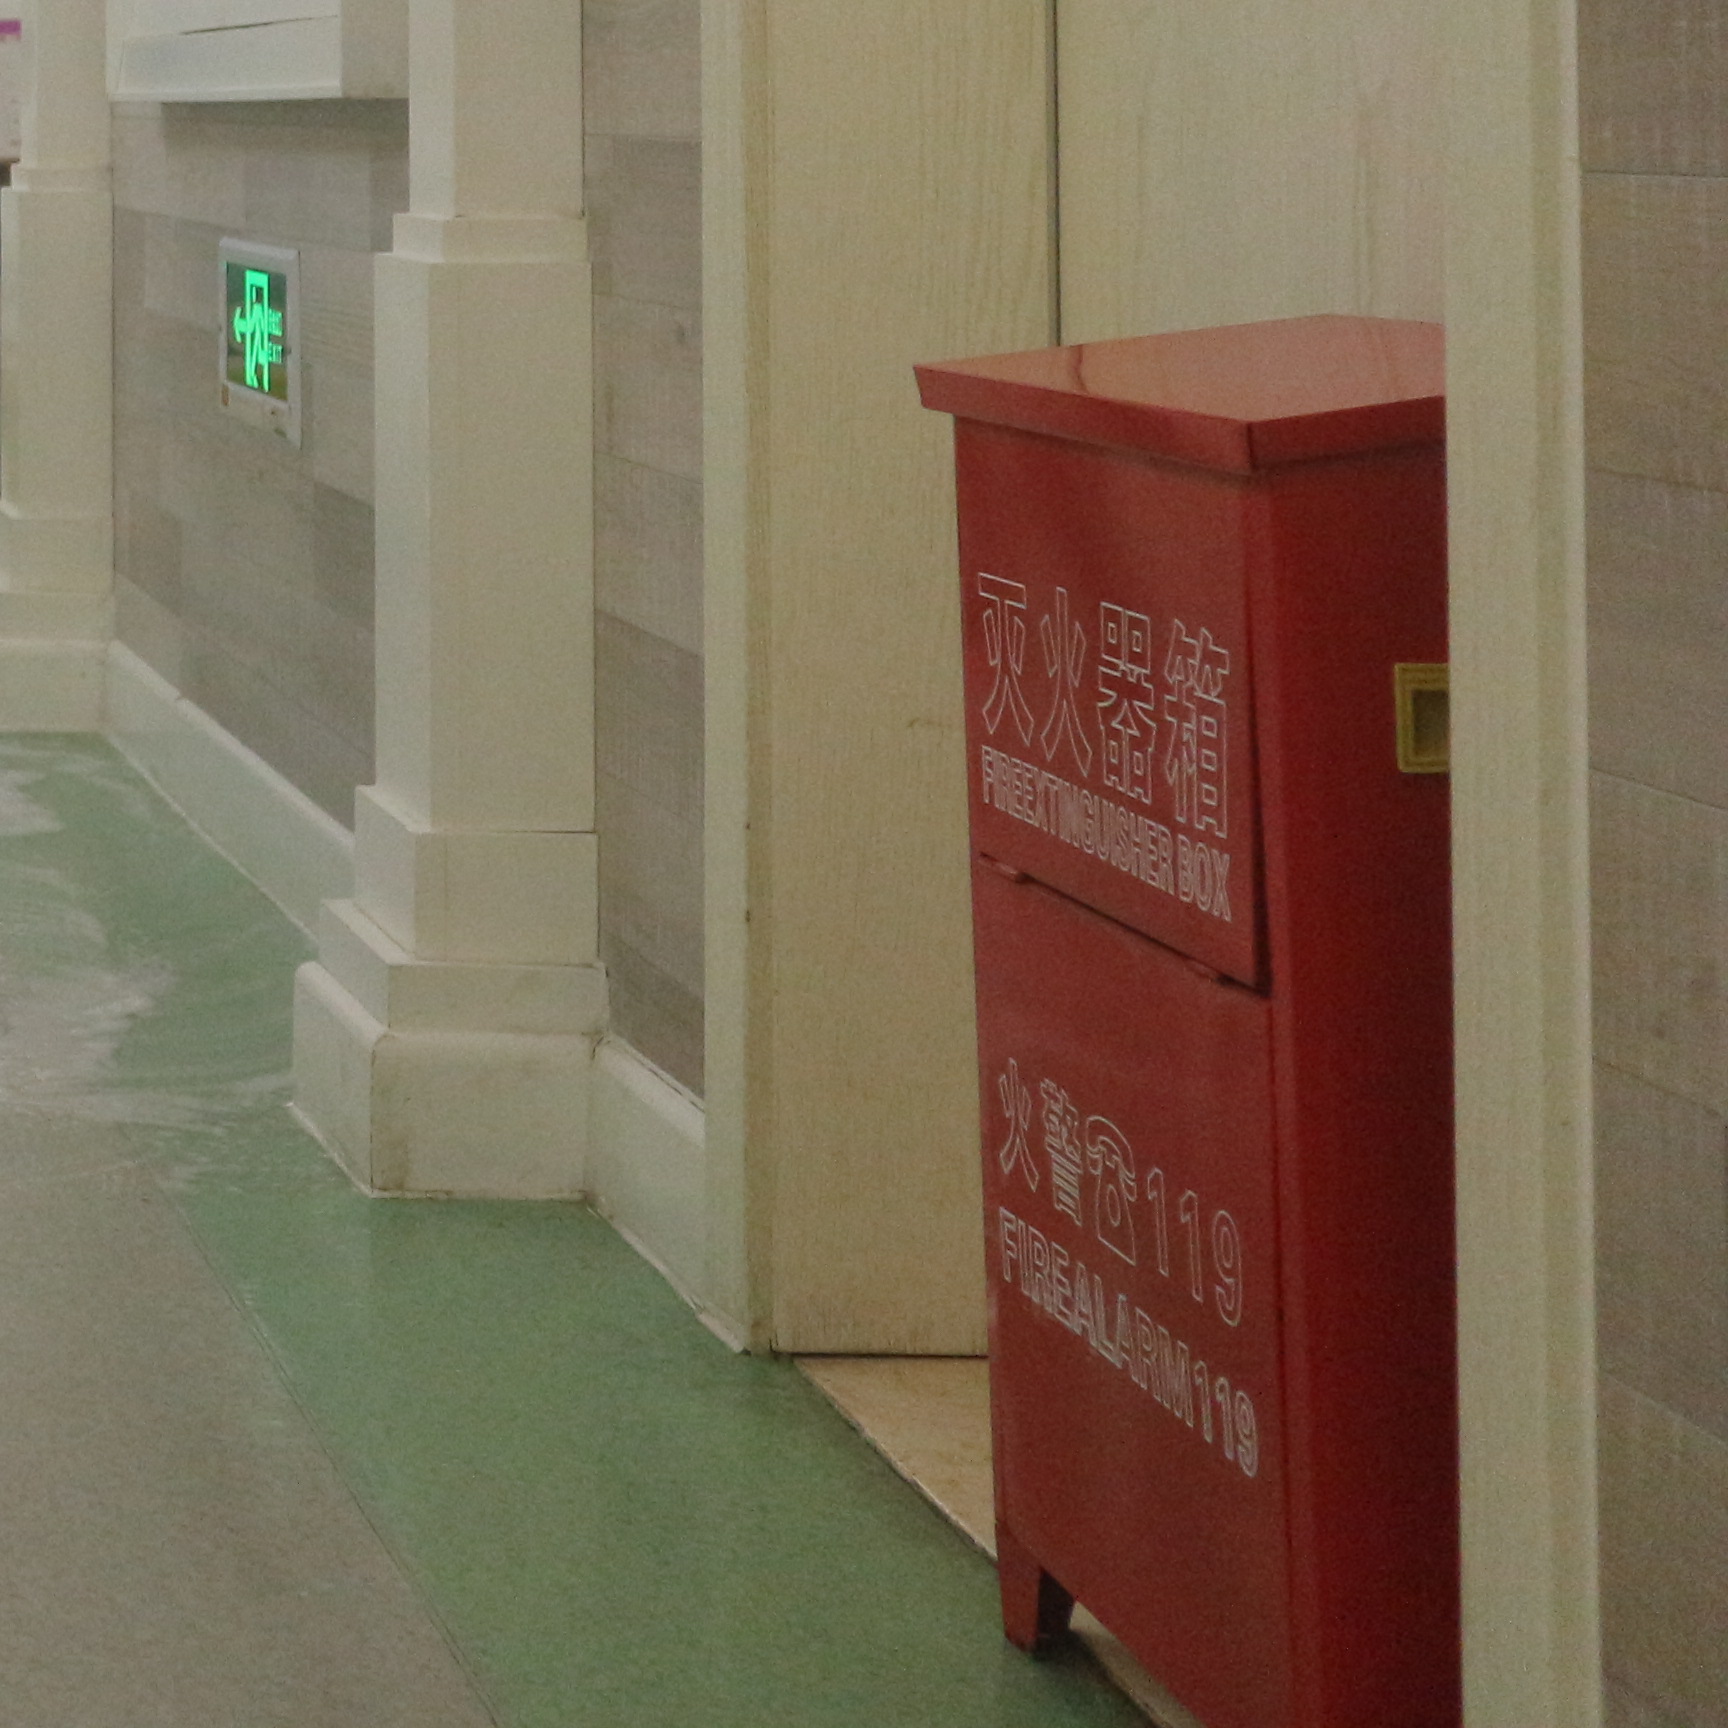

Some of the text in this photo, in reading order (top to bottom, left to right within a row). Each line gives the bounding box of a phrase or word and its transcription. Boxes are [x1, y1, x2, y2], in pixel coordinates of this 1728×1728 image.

[978, 572, 1230, 839] 灭火器箱
[1176, 833, 1231, 922] BOX
[1147, 1167, 1242, 1327] 119
